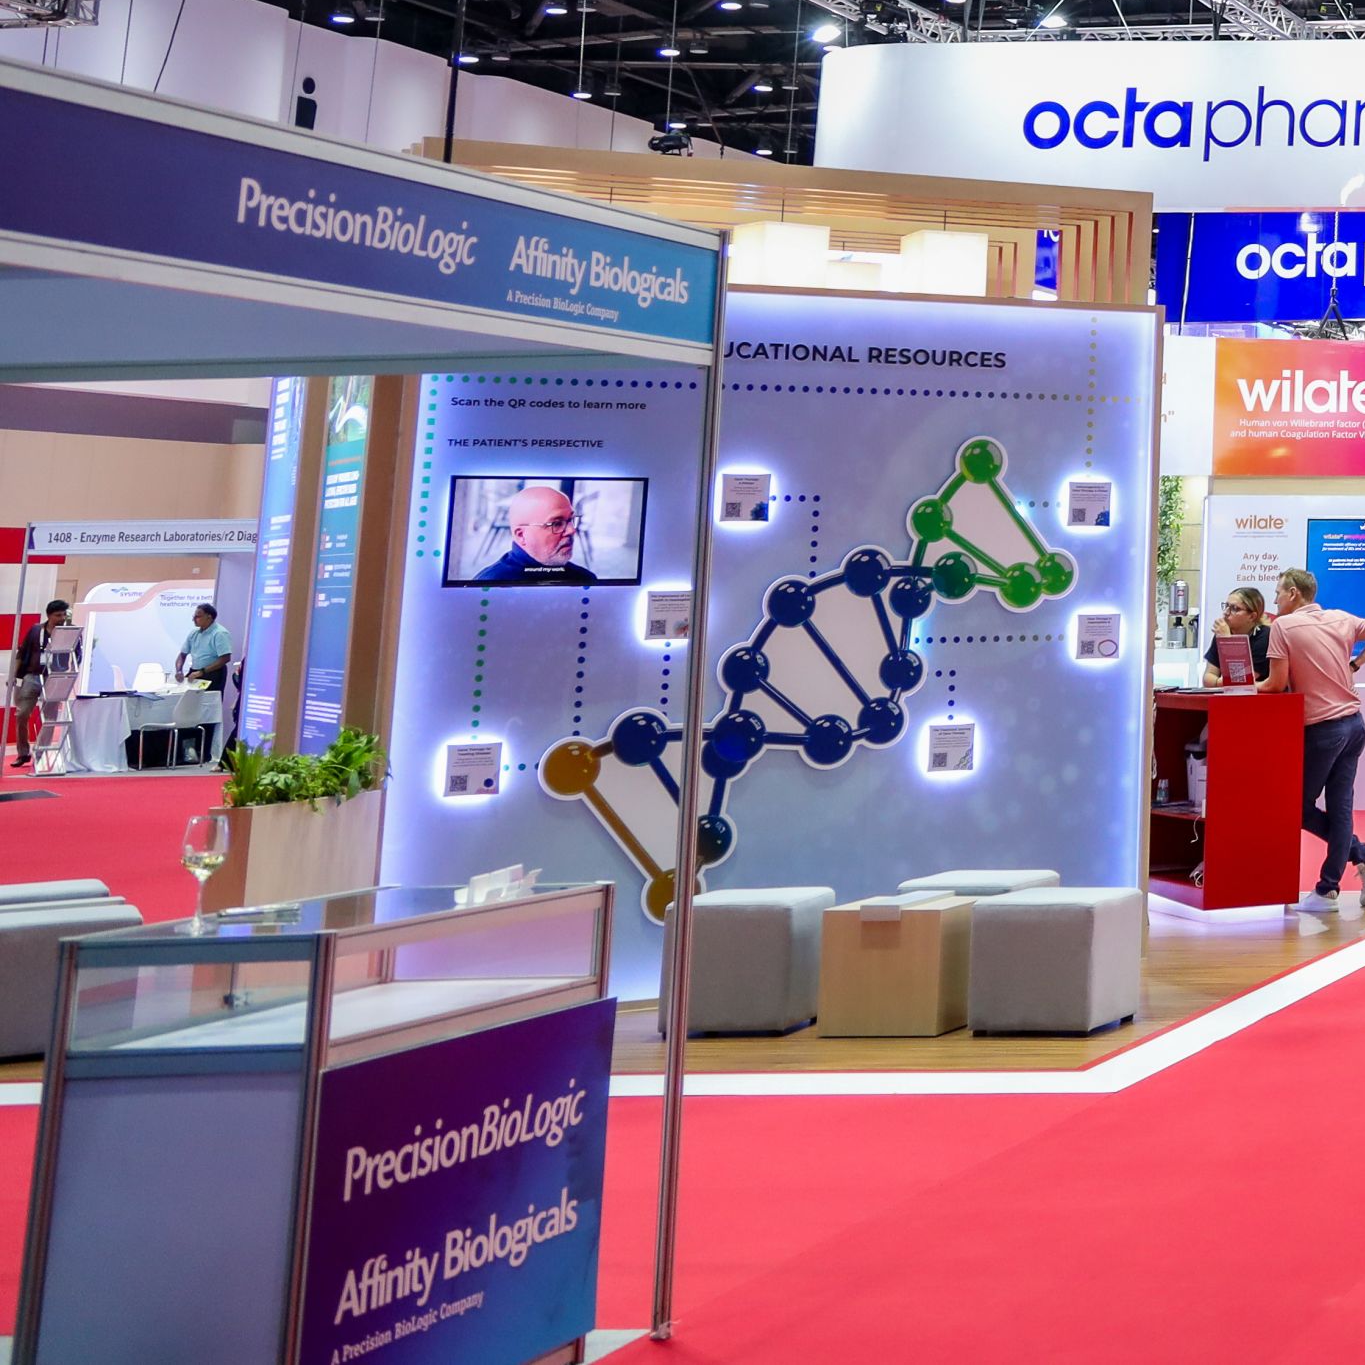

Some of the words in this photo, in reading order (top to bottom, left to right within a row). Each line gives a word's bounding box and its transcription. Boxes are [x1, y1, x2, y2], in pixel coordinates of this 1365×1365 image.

[237, 177, 479, 275] PrecisionBioLogic
[509, 235, 588, 295] Affinity
[589, 250, 689, 309] Biologicals
[506, 289, 515, 302] A
[515, 291, 551, 309] Precision
[552, 297, 585, 316] BioLogic
[585, 303, 619, 322] Company
[869, 344, 1007, 370] RESOURCES
[450, 397, 481, 407] Scan
[484, 398, 505, 407] the
[507, 398, 527, 409] QR
[529, 399, 565, 409] codes
[568, 400, 580, 409] to
[583, 400, 613, 410] learn
[615, 401, 648, 410] more
[1239, 418, 1271, 428] Human
[1272, 419, 1289, 428] von
[1290, 418, 1335, 428] Willebrand
[1336, 419, 1360, 429] factor
[1230, 429, 1248, 438] and
[1249, 430, 1279, 438] human
[1280, 429, 1331, 440] Coagulation
[1332, 430, 1358, 439] Factor
[448, 438, 469, 447] THE
[531, 439, 604, 448] PERSPECTIVE
[47, 531, 73, 544] 1408
[80, 531, 117, 545] Enzyme
[118, 531, 162, 543] Research
[163, 529, 235, 543] Laboratories/r2
[1242, 551, 1260, 562] Any
[1262, 551, 1280, 562] day.
[1240, 562, 1258, 573] Any
[1259, 562, 1281, 574] type.
[1236, 573, 1256, 583] Each
[159, 600, 190, 608] healthcare
[160, 594, 186, 602] Together
[343, 1077, 587, 1203] PrecisionBioLogic
[333, 1246, 440, 1326] Affinity
[443, 1186, 579, 1280] Biologicals
[330, 1348, 341, 1365] A
[342, 1329, 393, 1363] Precision
[394, 1308, 438, 1340] BioLogic
[439, 1290, 485, 1320] Company
